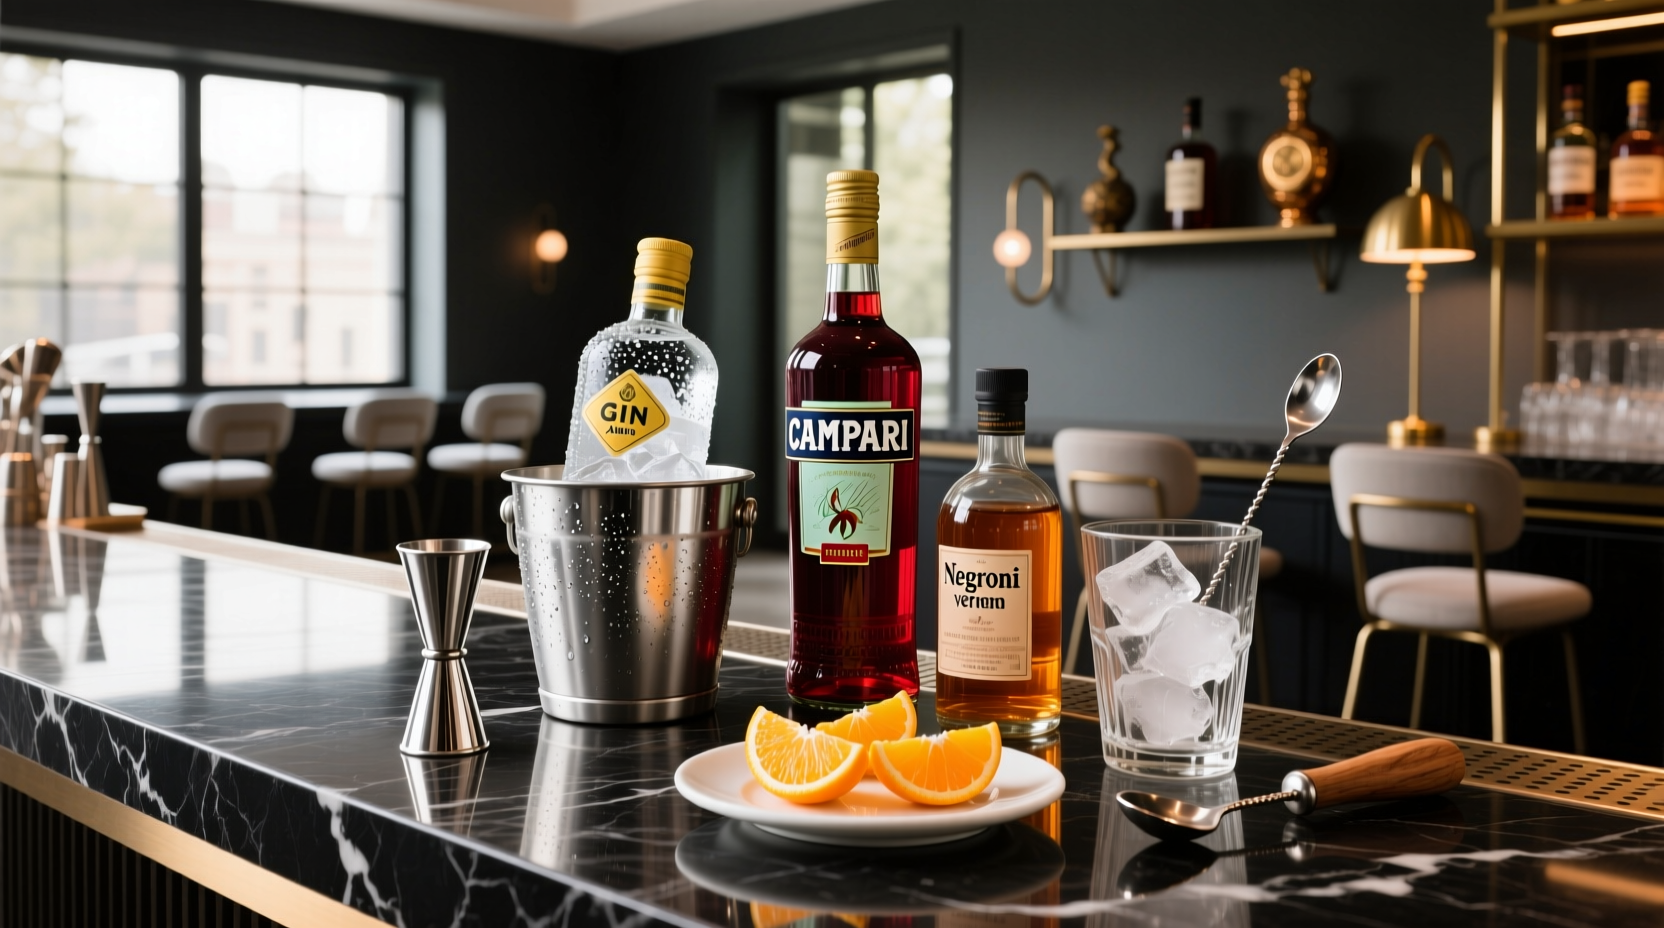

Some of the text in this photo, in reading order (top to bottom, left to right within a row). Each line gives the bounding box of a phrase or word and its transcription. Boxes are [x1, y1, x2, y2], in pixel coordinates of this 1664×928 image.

[600, 402, 648, 426] GIN
[789, 417, 908, 452] CAMPARI
[945, 562, 1020, 593] Negroni
